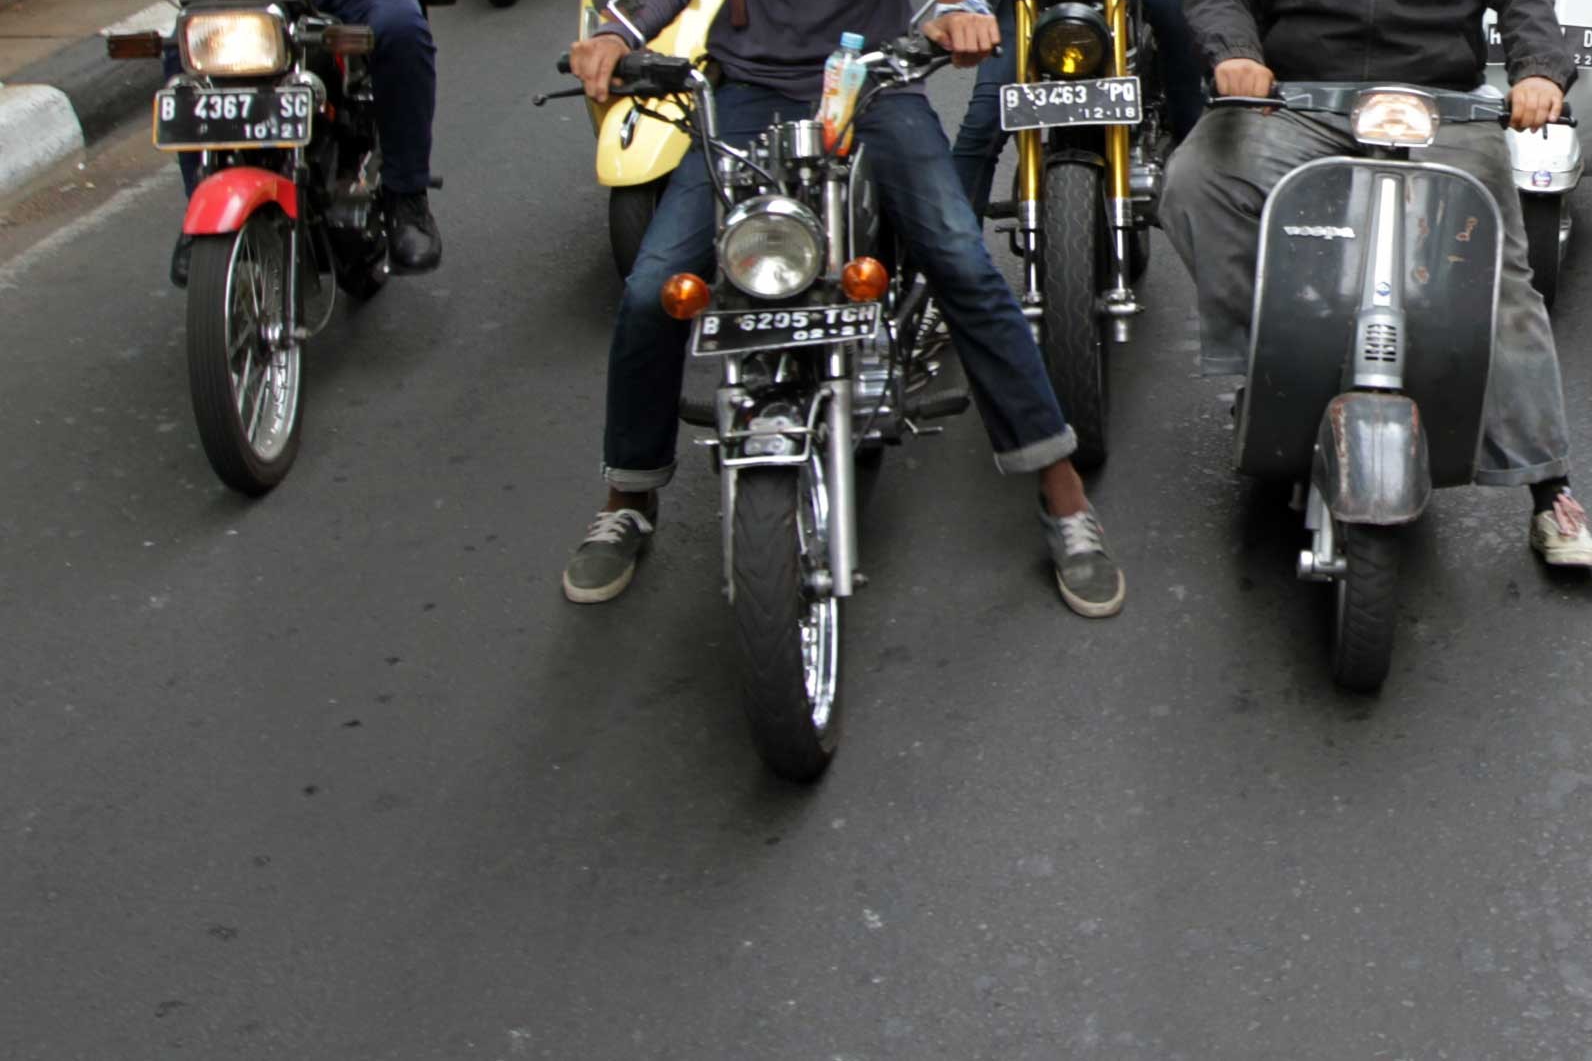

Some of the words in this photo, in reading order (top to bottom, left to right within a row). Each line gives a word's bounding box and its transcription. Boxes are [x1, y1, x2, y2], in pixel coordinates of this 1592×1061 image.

[161, 96, 175, 121] B
[194, 94, 253, 119] 4367
[1006, 89, 1019, 108] B
[1034, 85, 1087, 106] 3463
[702, 316, 721, 335] B
